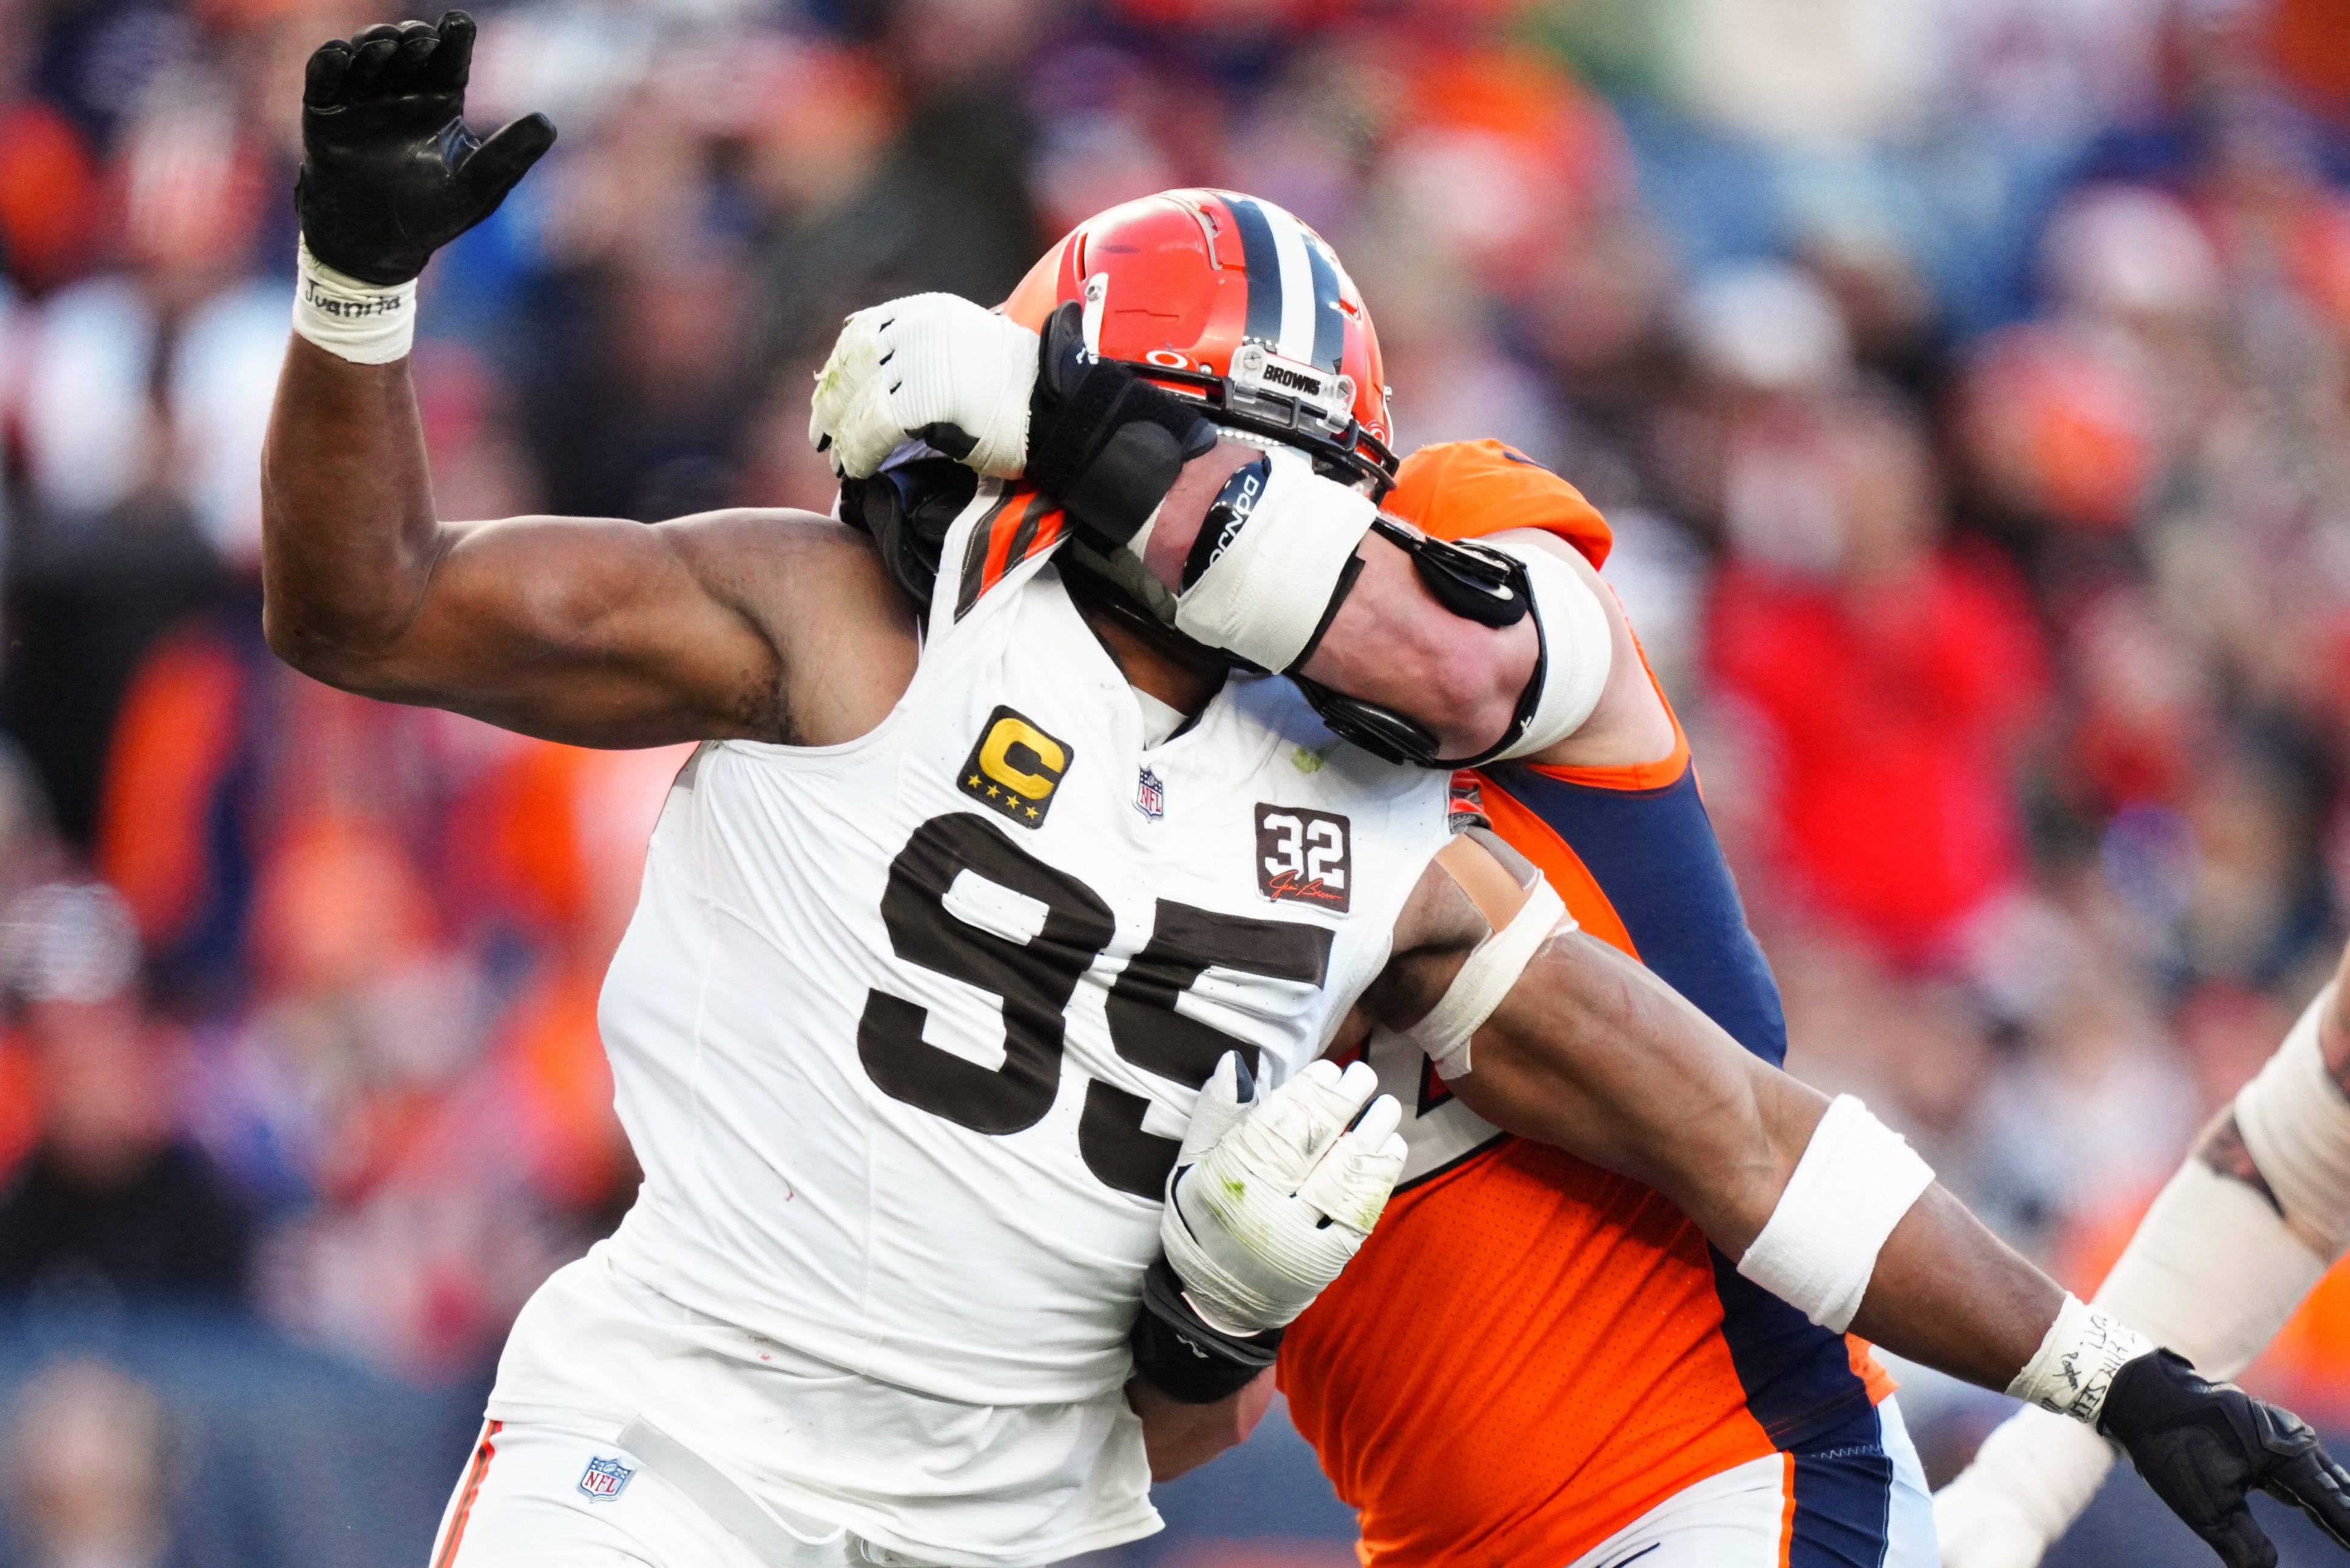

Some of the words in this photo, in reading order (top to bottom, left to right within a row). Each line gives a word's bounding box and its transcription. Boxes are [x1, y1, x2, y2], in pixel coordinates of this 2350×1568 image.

[305, 276, 401, 317] Juanita
[1263, 364, 1321, 395] BROWNS
[1204, 475, 1260, 569] DONJO
[979, 718, 1065, 801] C
[1140, 785, 1161, 812] NFL
[1263, 813, 1344, 889] 32
[857, 812, 1335, 1203] 95
[584, 1471, 616, 1493] NFL
